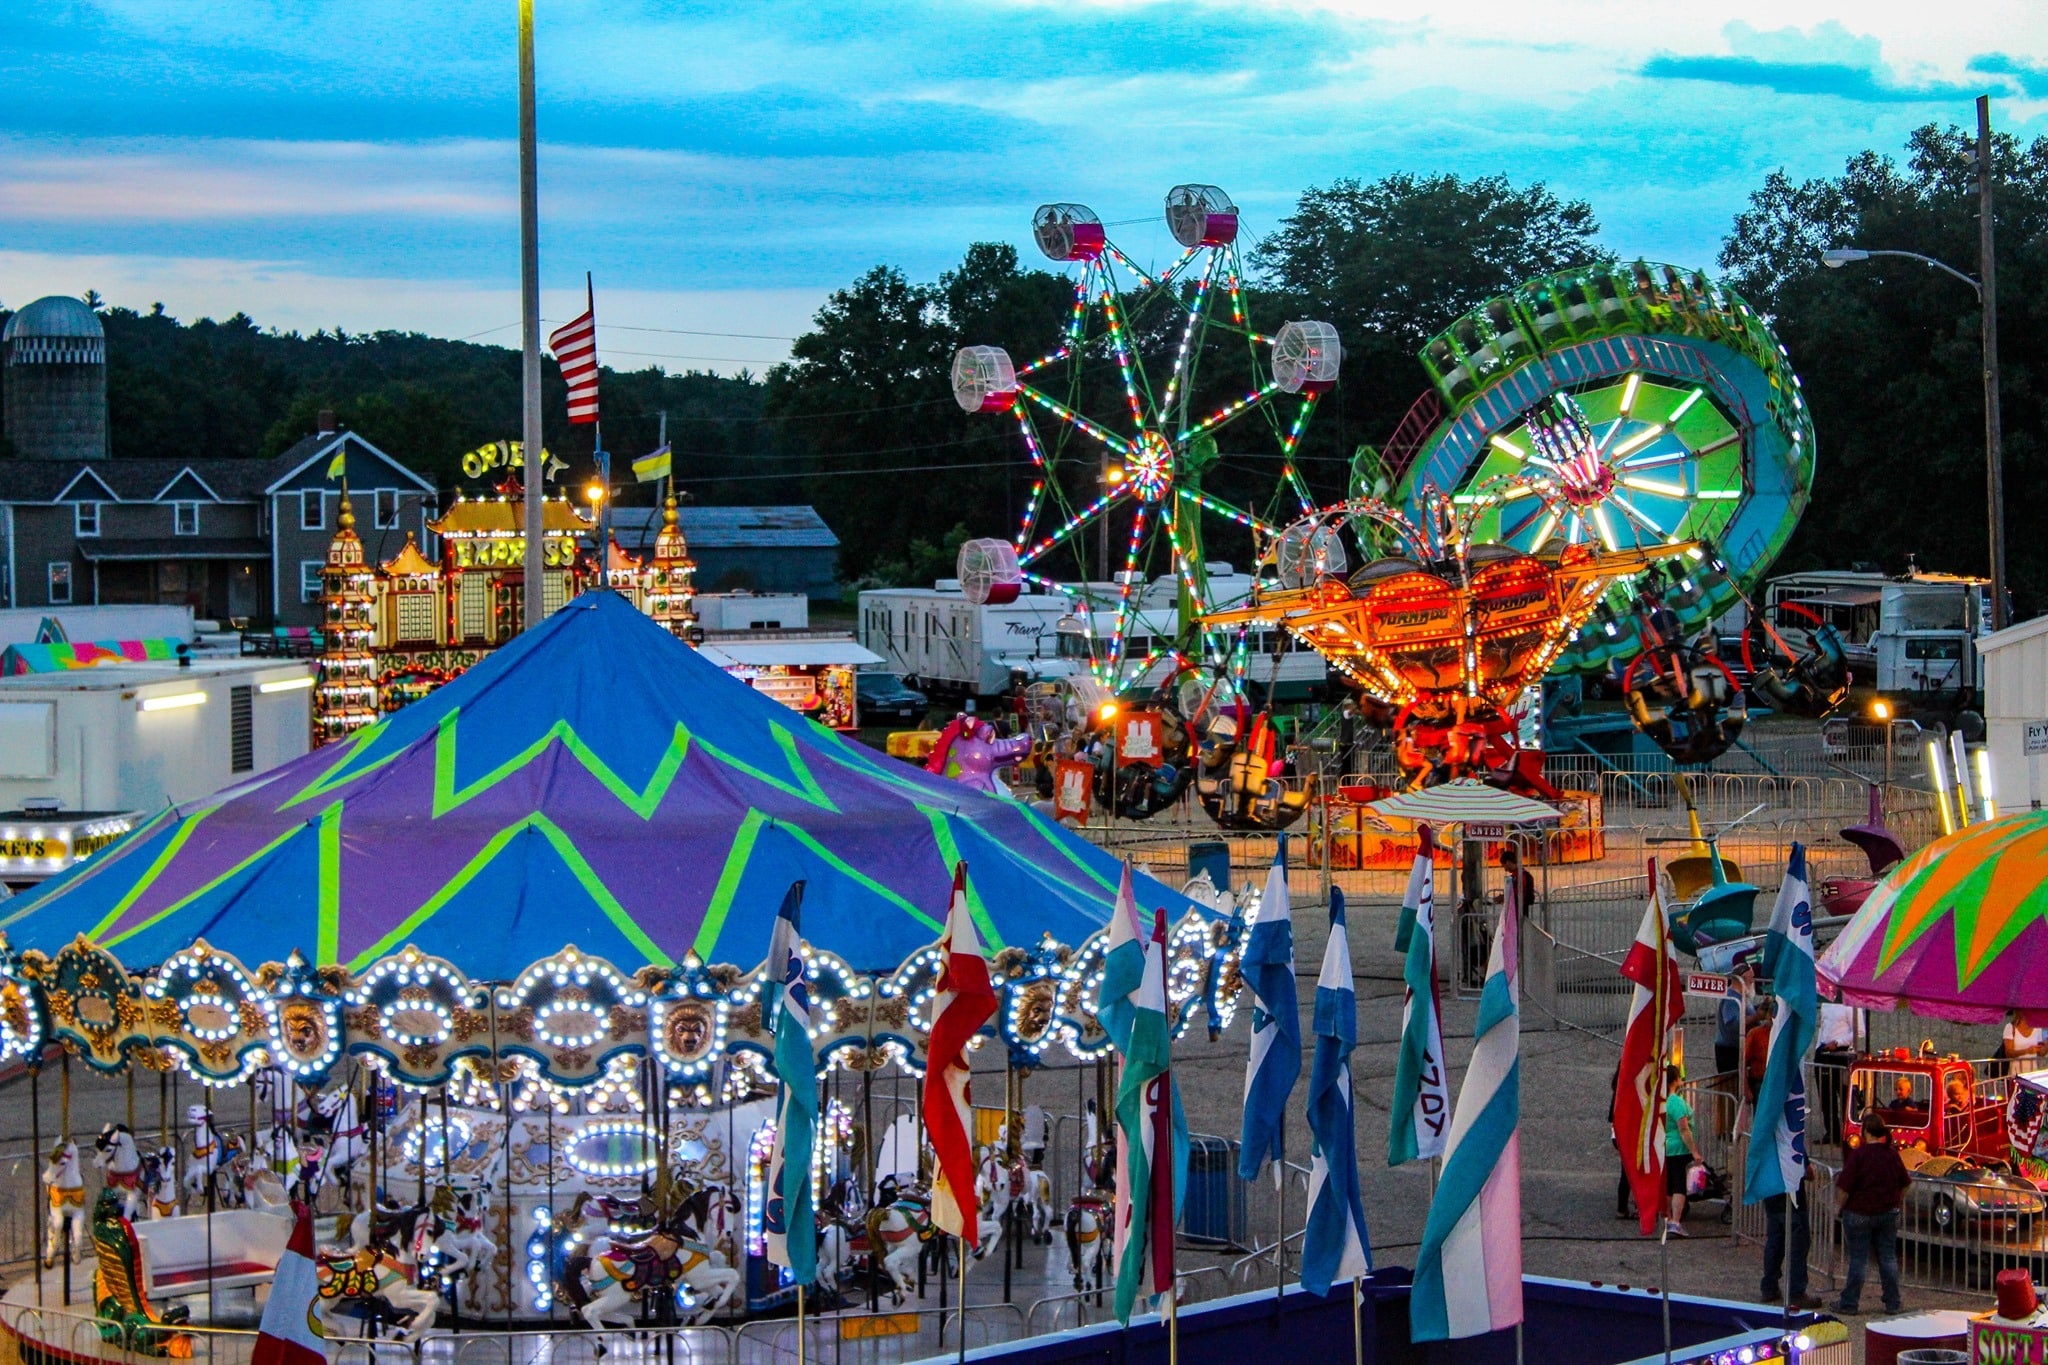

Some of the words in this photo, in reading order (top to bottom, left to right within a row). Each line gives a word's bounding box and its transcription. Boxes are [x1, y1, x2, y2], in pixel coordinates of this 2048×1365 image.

[462, 439, 570, 482] ORIET
[456, 538, 575, 566] EXPRSS
[1004, 622, 1046, 635] Travel
[1375, 607, 1449, 632] TORNADO
[1471, 825, 1502, 836] ENTER
[1690, 977, 1724, 991] ENTER
[1978, 1328, 2033, 1365] SOFT
